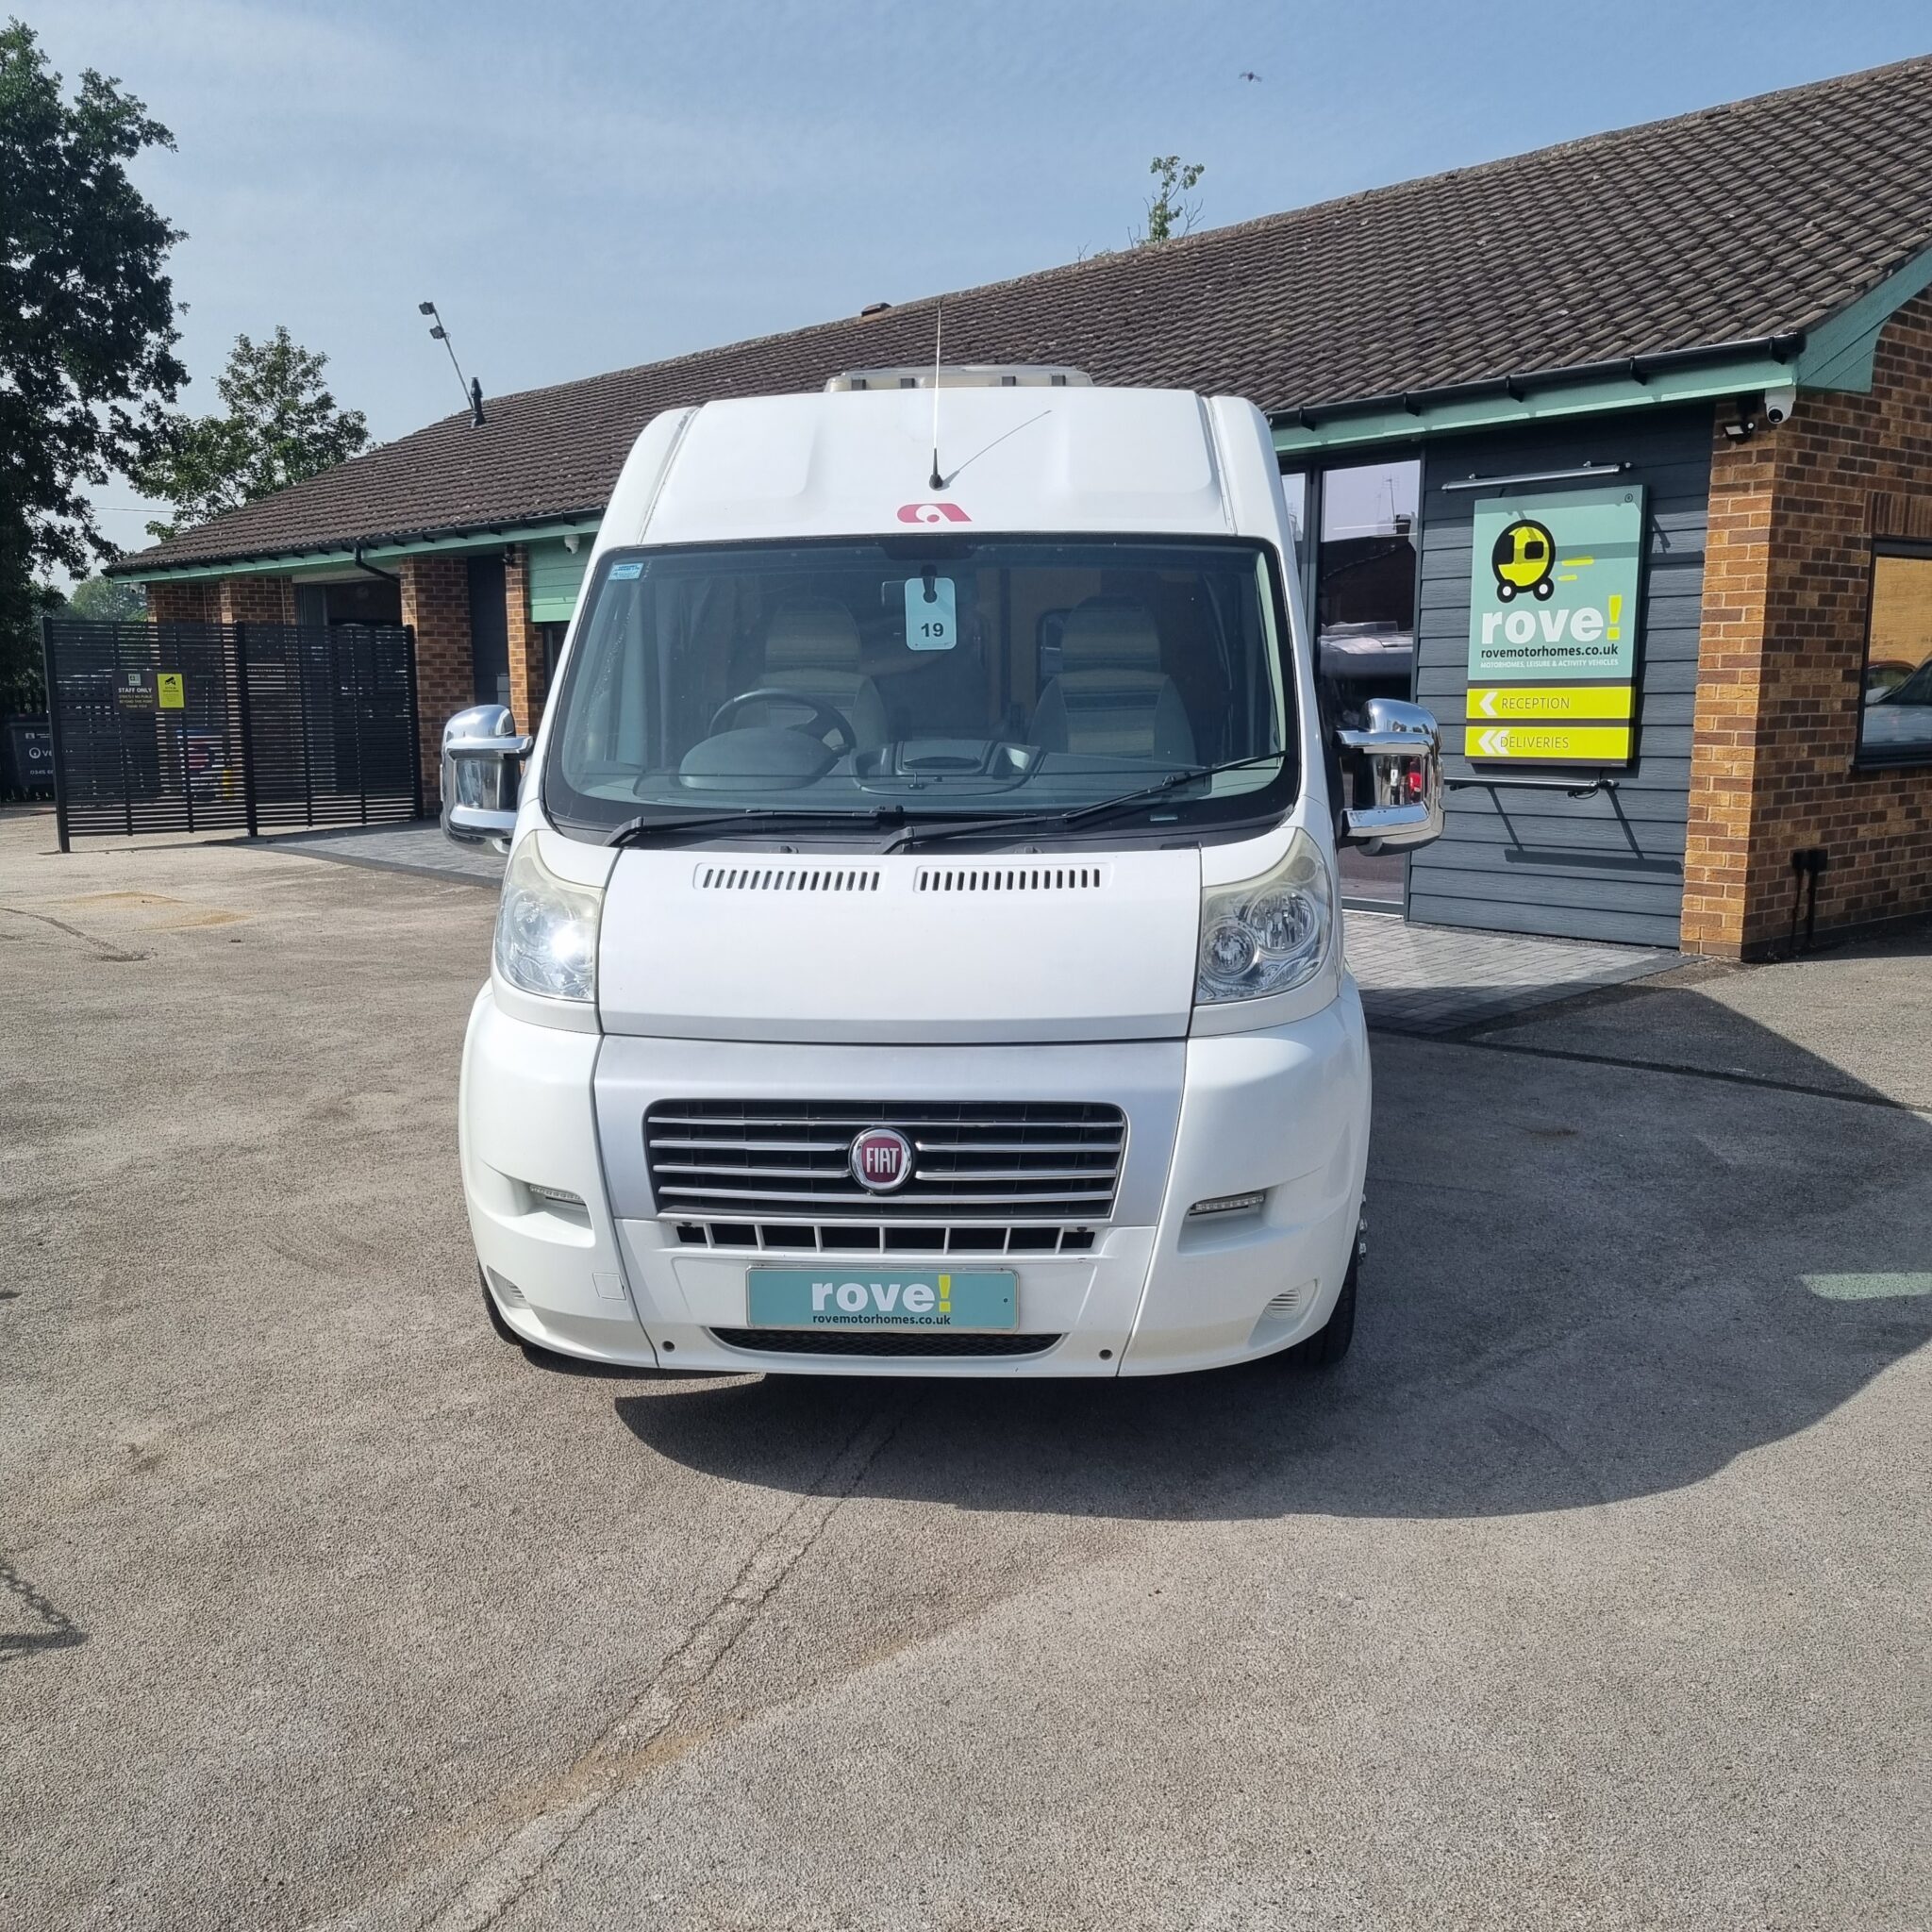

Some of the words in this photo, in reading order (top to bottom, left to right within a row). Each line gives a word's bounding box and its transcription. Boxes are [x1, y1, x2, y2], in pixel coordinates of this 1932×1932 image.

[1481, 594, 1623, 644] rove!
[921, 623, 944, 638] 19
[1481, 643, 1619, 658] rovemotorhomes.co.uk
[1502, 697, 1570, 709] RECEPTION
[1500, 736, 1569, 748] DELIVERIES
[866, 1147, 899, 1174] FIAT
[811, 1274, 951, 1313] rove!
[812, 1314, 951, 1324] rovemotorhomes.co.uk
